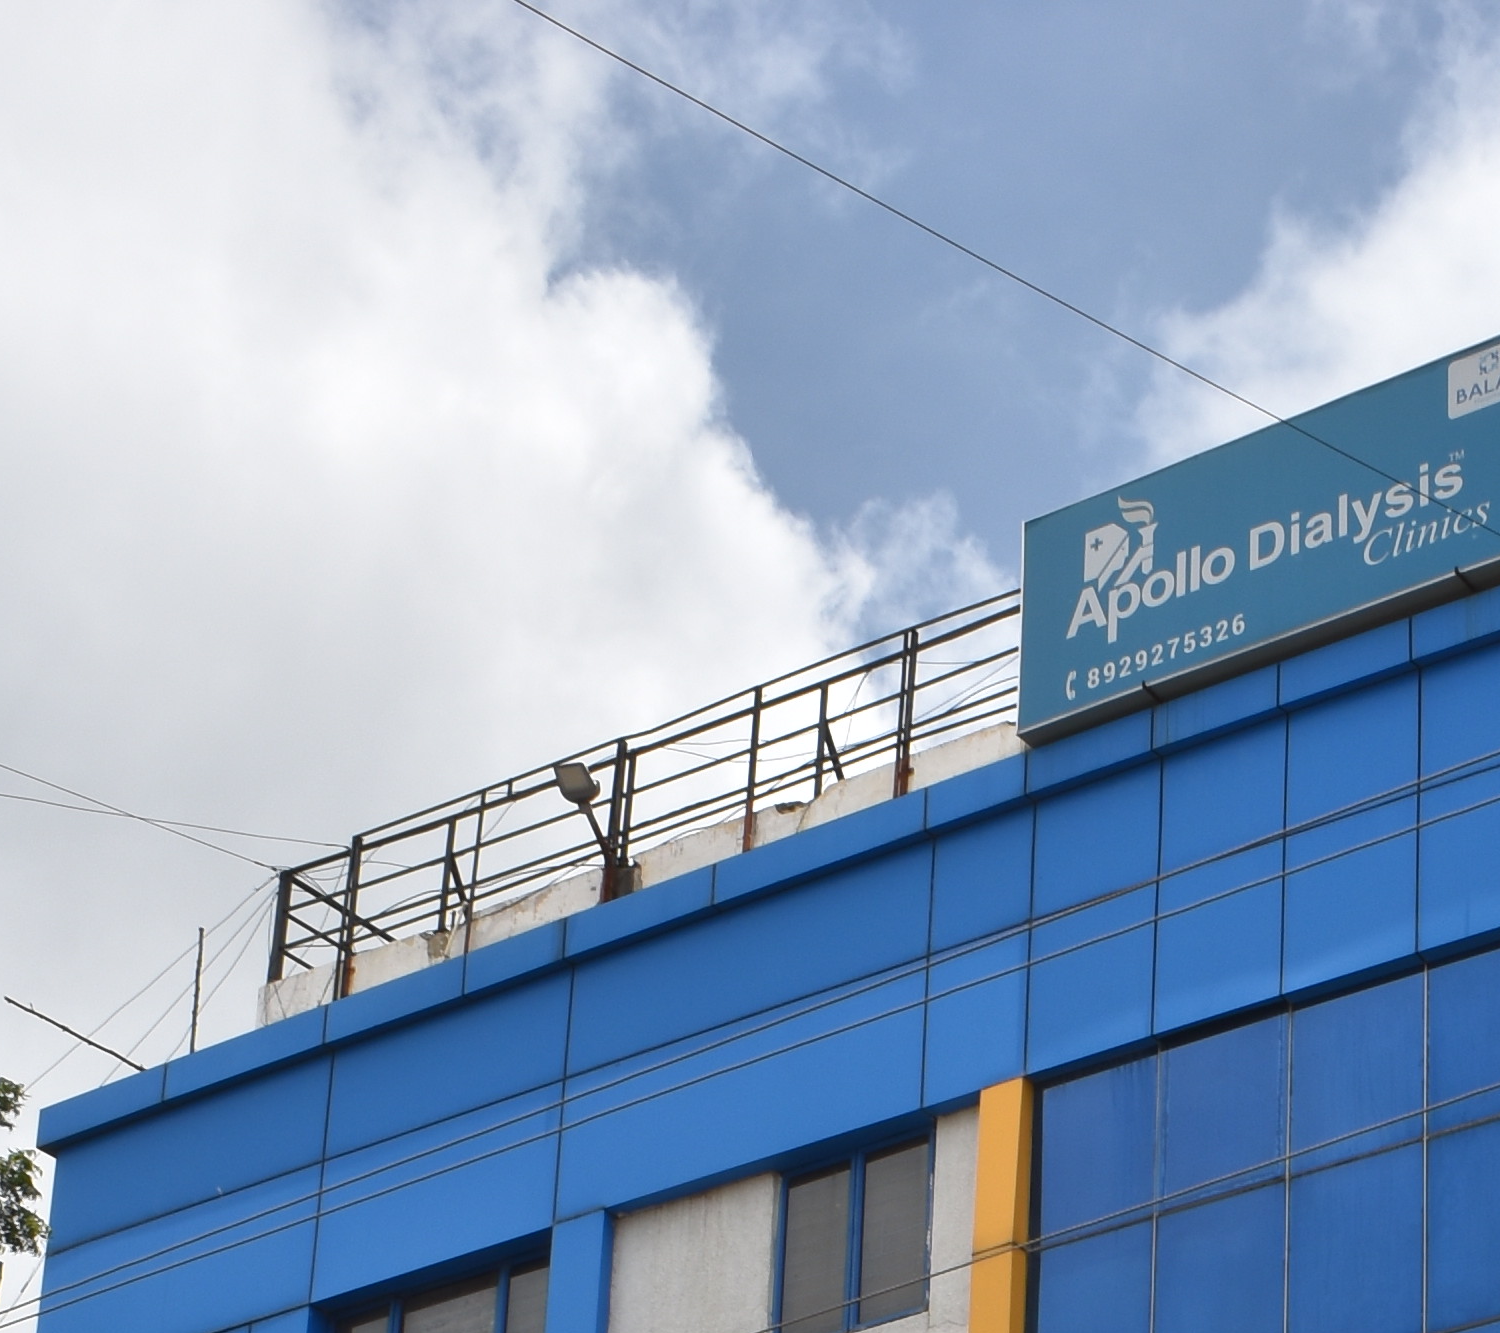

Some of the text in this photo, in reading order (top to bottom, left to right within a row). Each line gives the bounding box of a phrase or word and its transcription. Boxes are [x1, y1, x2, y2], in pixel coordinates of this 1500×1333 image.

[1065, 463, 1464, 645] Apollo Dialysis
[1363, 500, 1490, 566] Clinics
[1087, 613, 1246, 689] 8929275326
